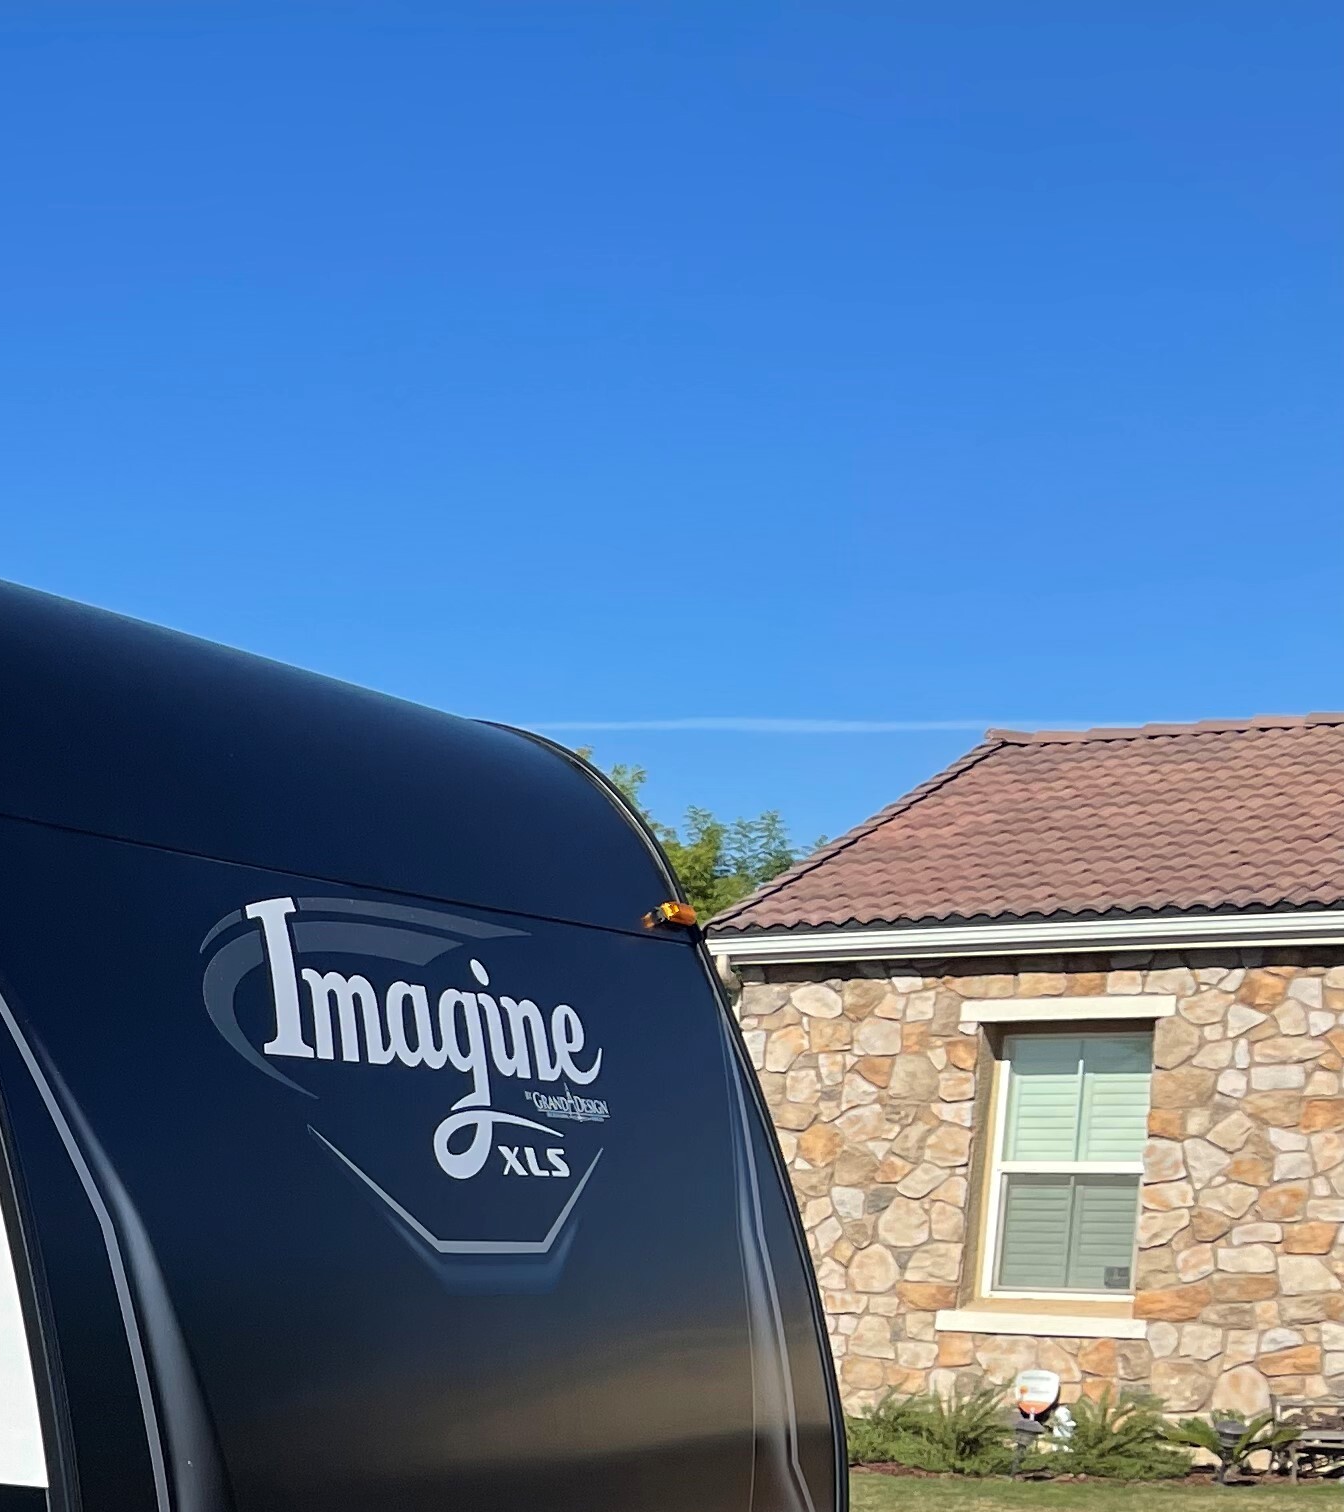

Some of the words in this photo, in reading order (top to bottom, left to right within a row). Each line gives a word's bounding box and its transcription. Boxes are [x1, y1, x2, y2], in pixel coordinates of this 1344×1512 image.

[244, 896, 603, 1180] Imagine
[532, 1091, 568, 1112] GRAND
[573, 1095, 610, 1115] DESIGN
[497, 1145, 570, 1177] XLS
